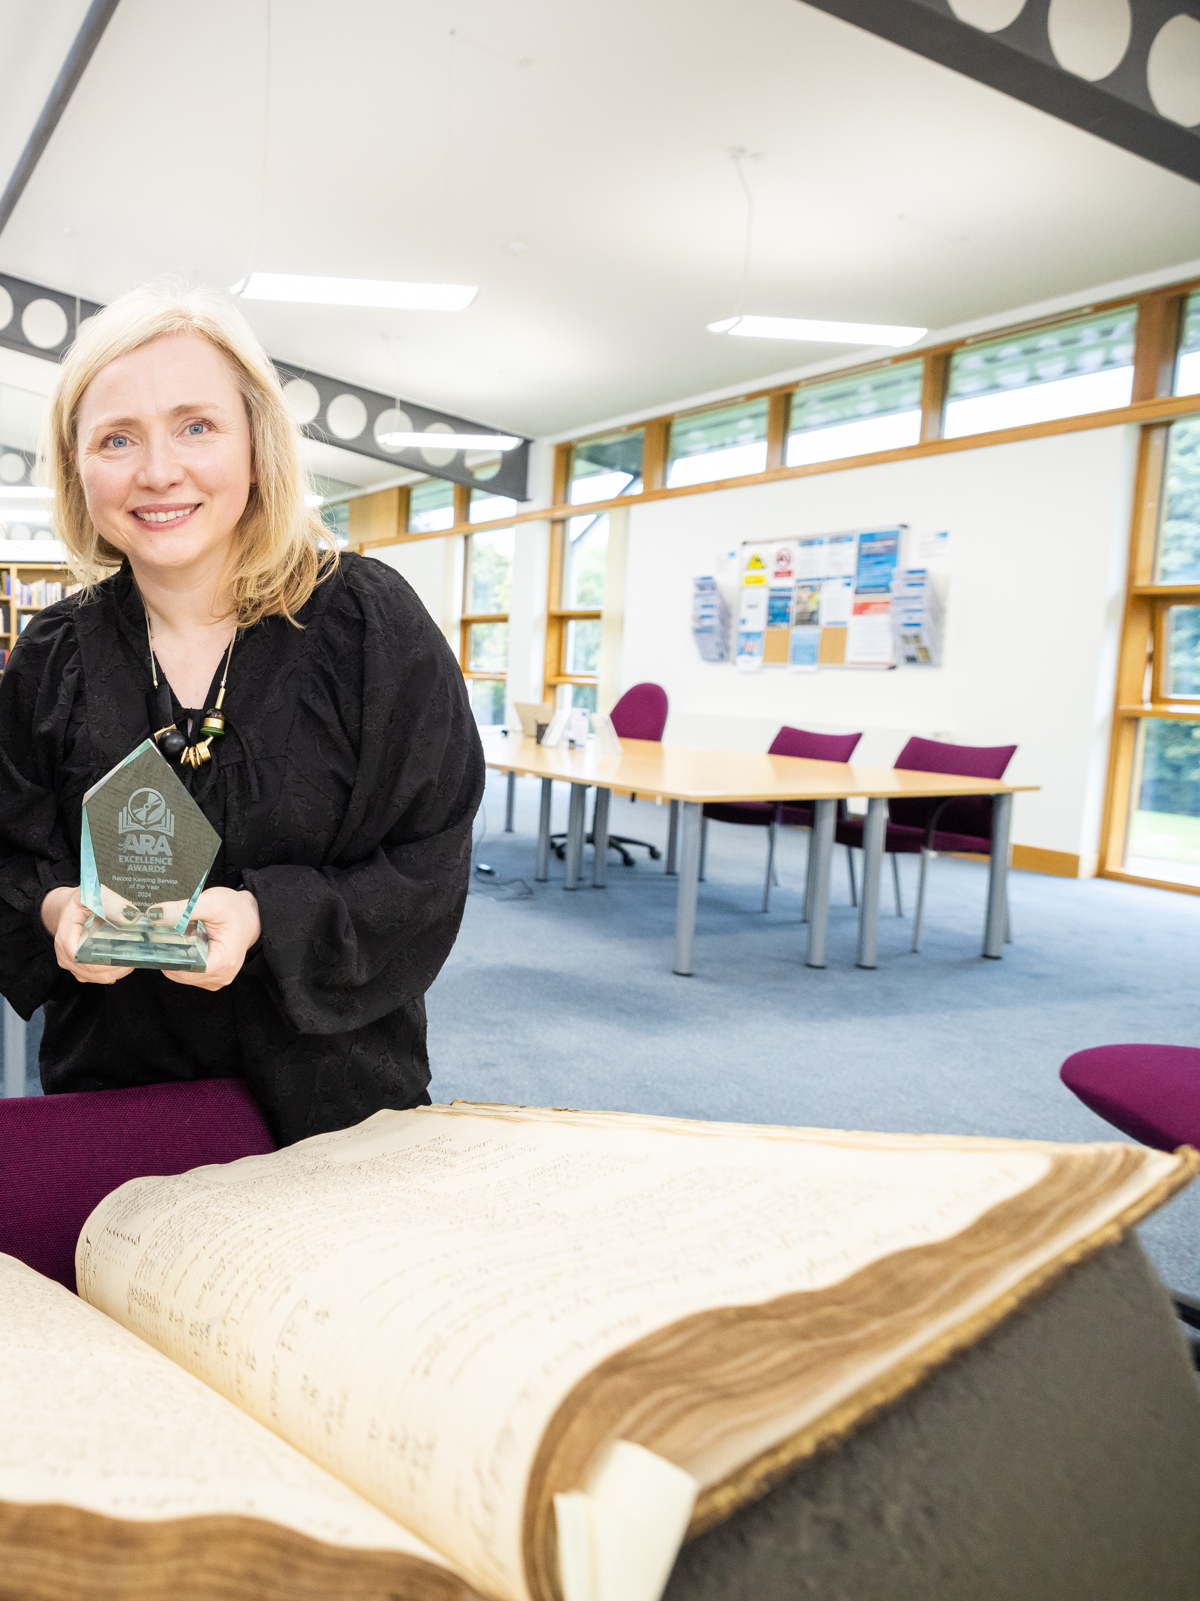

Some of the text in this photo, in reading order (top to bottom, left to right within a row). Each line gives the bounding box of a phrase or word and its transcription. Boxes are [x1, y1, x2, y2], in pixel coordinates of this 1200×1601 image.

[118, 833, 173, 857] ARA
[118, 855, 173, 866] EXCELLENCE
[126, 864, 166, 873] AWARDS
[133, 876, 156, 884] Keeping
